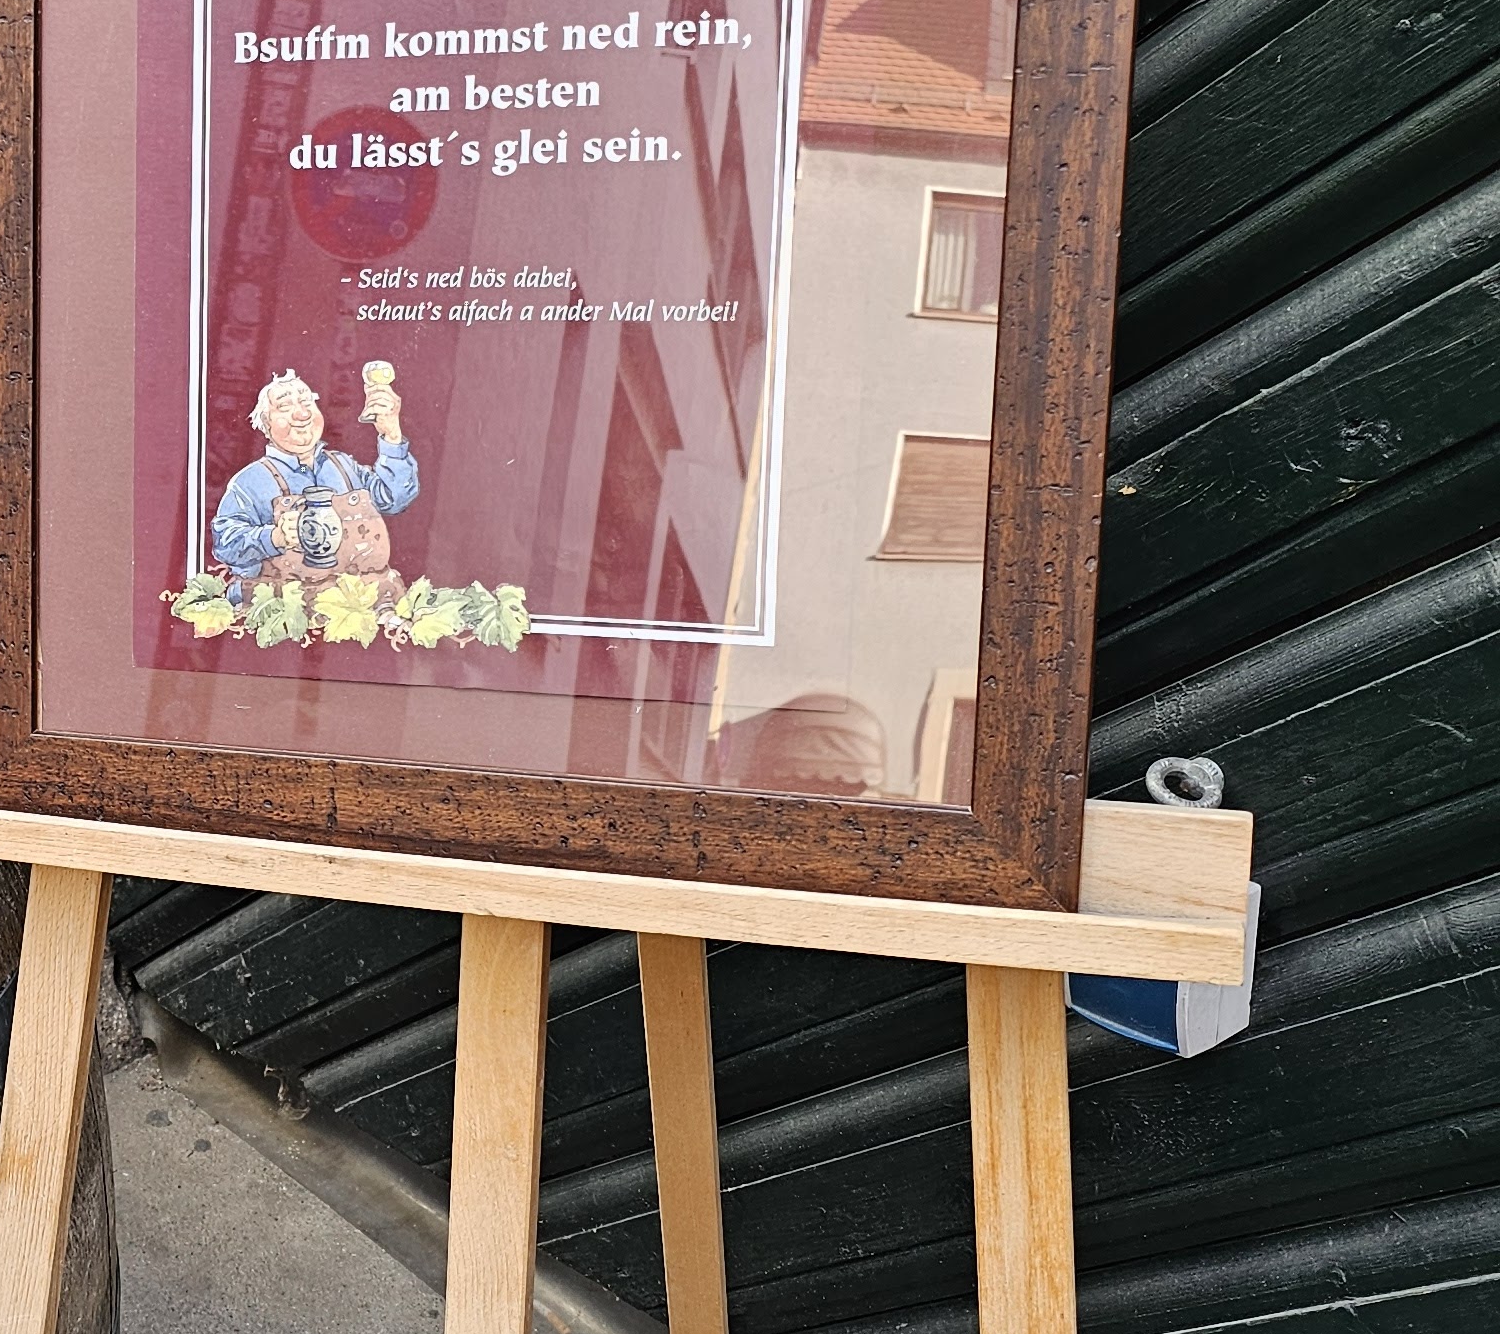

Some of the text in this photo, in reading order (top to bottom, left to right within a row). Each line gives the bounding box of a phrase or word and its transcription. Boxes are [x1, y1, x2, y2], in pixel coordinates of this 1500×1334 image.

[234, 10, 752, 64] Bsuffm kommst ned rein,
[389, 74, 600, 113] am besten
[289, 134, 337, 170] du
[491, 128, 568, 177] glei
[582, 127, 682, 163] sein.
[425, 265, 465, 288] ned
[469, 265, 507, 288] bös
[513, 265, 577, 291] dabei,
[448, 298, 514, 327] aifach
[519, 305, 535, 321] a
[540, 298, 604, 322] ander
[608, 298, 655, 322] Mal
[661, 298, 739, 322] vorbei!
